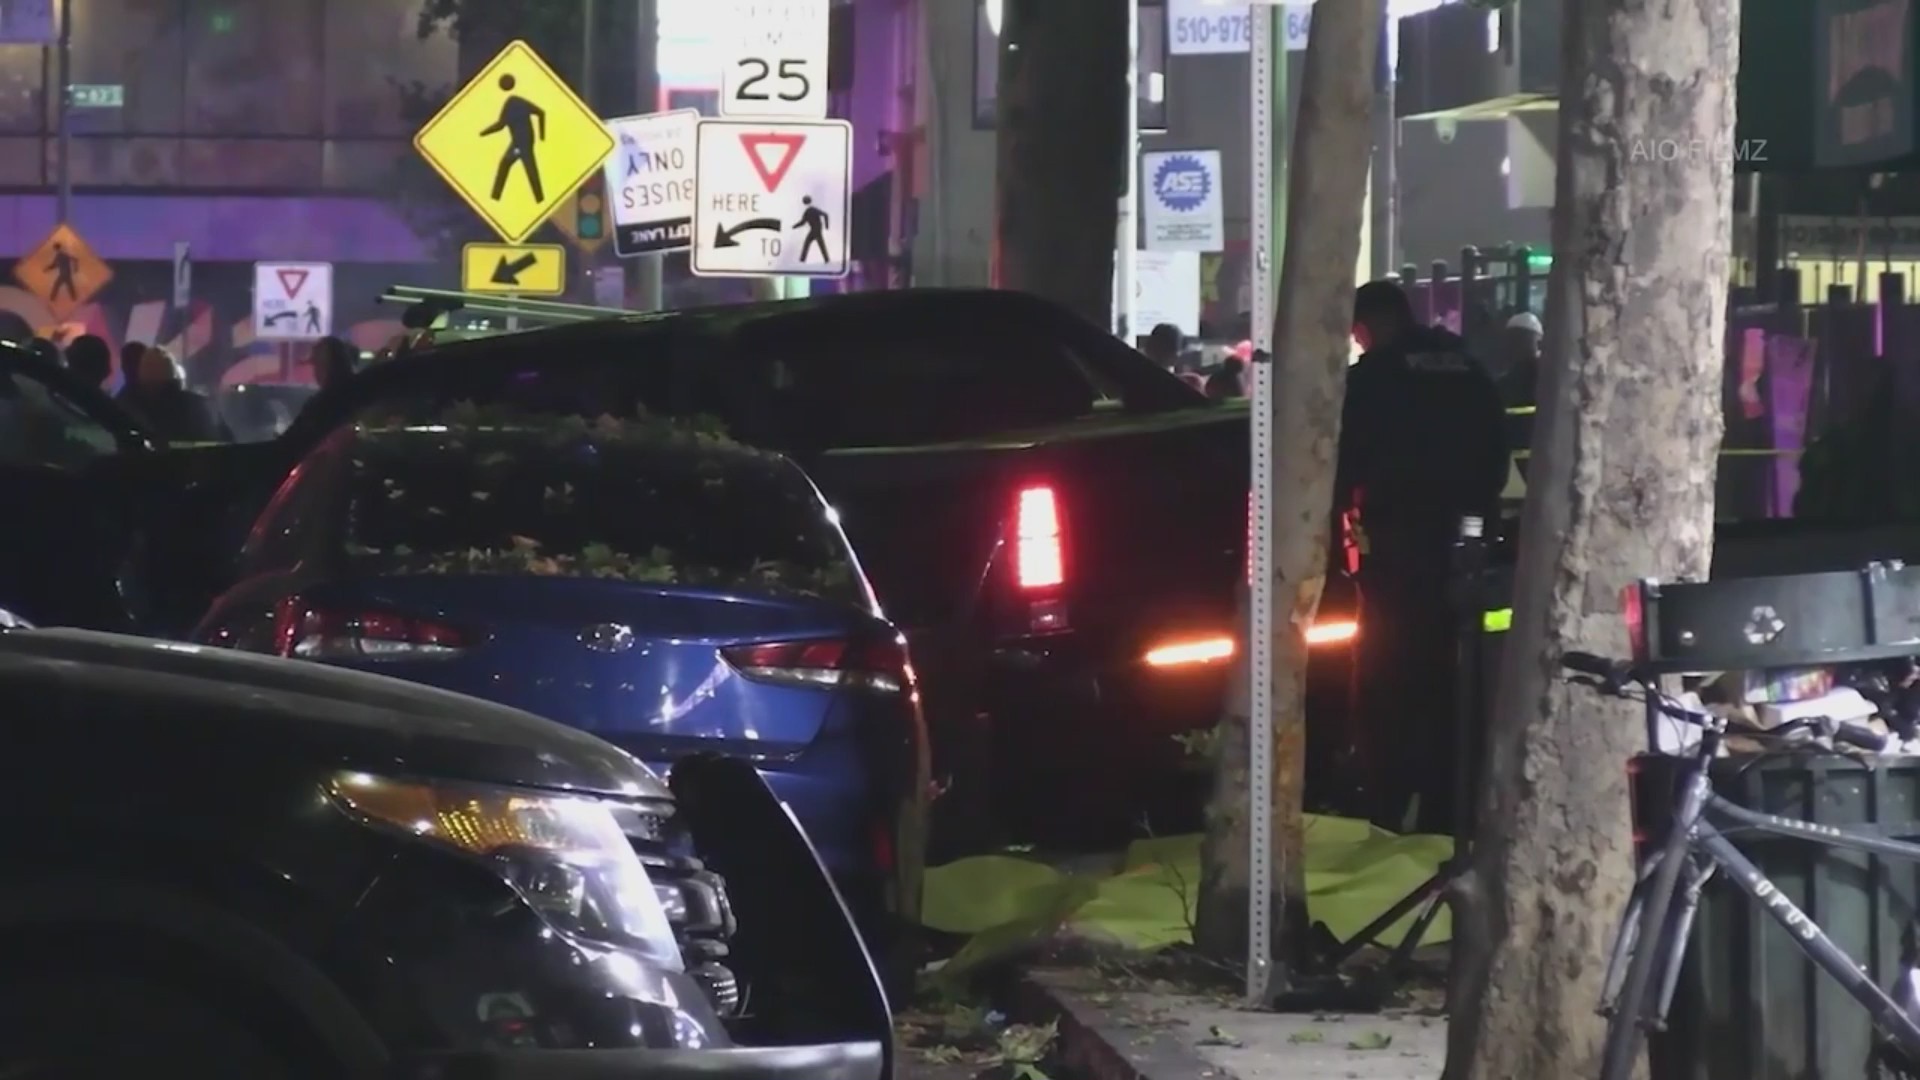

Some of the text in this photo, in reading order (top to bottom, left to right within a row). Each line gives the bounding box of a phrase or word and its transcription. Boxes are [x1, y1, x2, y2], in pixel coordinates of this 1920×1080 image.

[736, 57, 809, 101] 25
[627, 147, 684, 176] ONLY
[1161, 171, 1202, 192] ASE
[712, 193, 760, 212] HERE
[760, 238, 782, 257] TO
